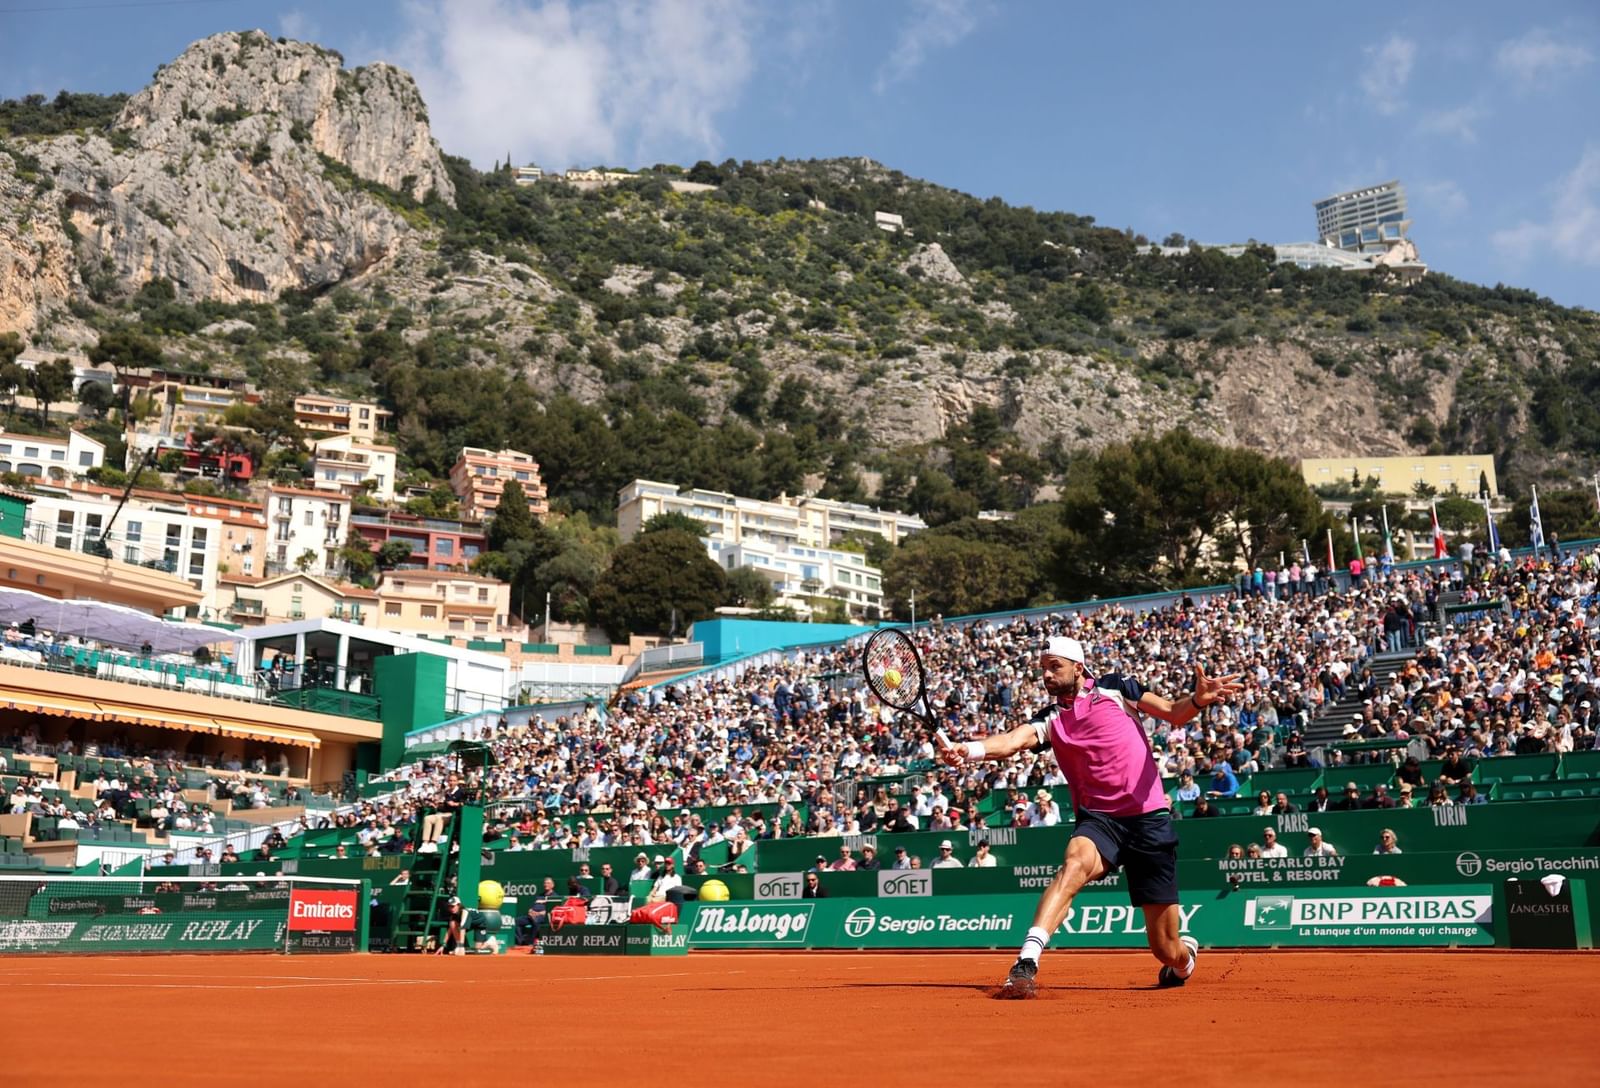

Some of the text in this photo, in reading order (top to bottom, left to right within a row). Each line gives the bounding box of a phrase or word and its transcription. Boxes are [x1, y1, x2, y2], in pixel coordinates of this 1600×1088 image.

[1278, 814, 1309, 833] PARIS
[1432, 804, 1468, 826] TURIN
[968, 828, 1017, 846] CINCINNATI
[1218, 856, 1346, 870] MONTE-CARLO BAY
[1486, 856, 1599, 873] Sergio Tacchini
[1020, 876, 1055, 888] HOTE
[1273, 871, 1282, 881] &
[1287, 869, 1340, 881] RESORT
[503, 880, 537, 896] decco
[293, 901, 353, 918] Emirates
[1301, 900, 1477, 921] BNP PARIBAS
[1510, 903, 1570, 914] LANCASTER
[695, 907, 807, 940] Malongo
[878, 914, 1013, 934] Sergio Tacchini
[1055, 903, 1203, 934] REPLY
[181, 919, 263, 941] REPLAY
[1300, 926, 1478, 938] La banque d'un monde qui change
[542, 935, 622, 947] REPLAY REPLAY
[627, 937, 650, 945] REPLAY
[652, 934, 687, 948] REPLAY
